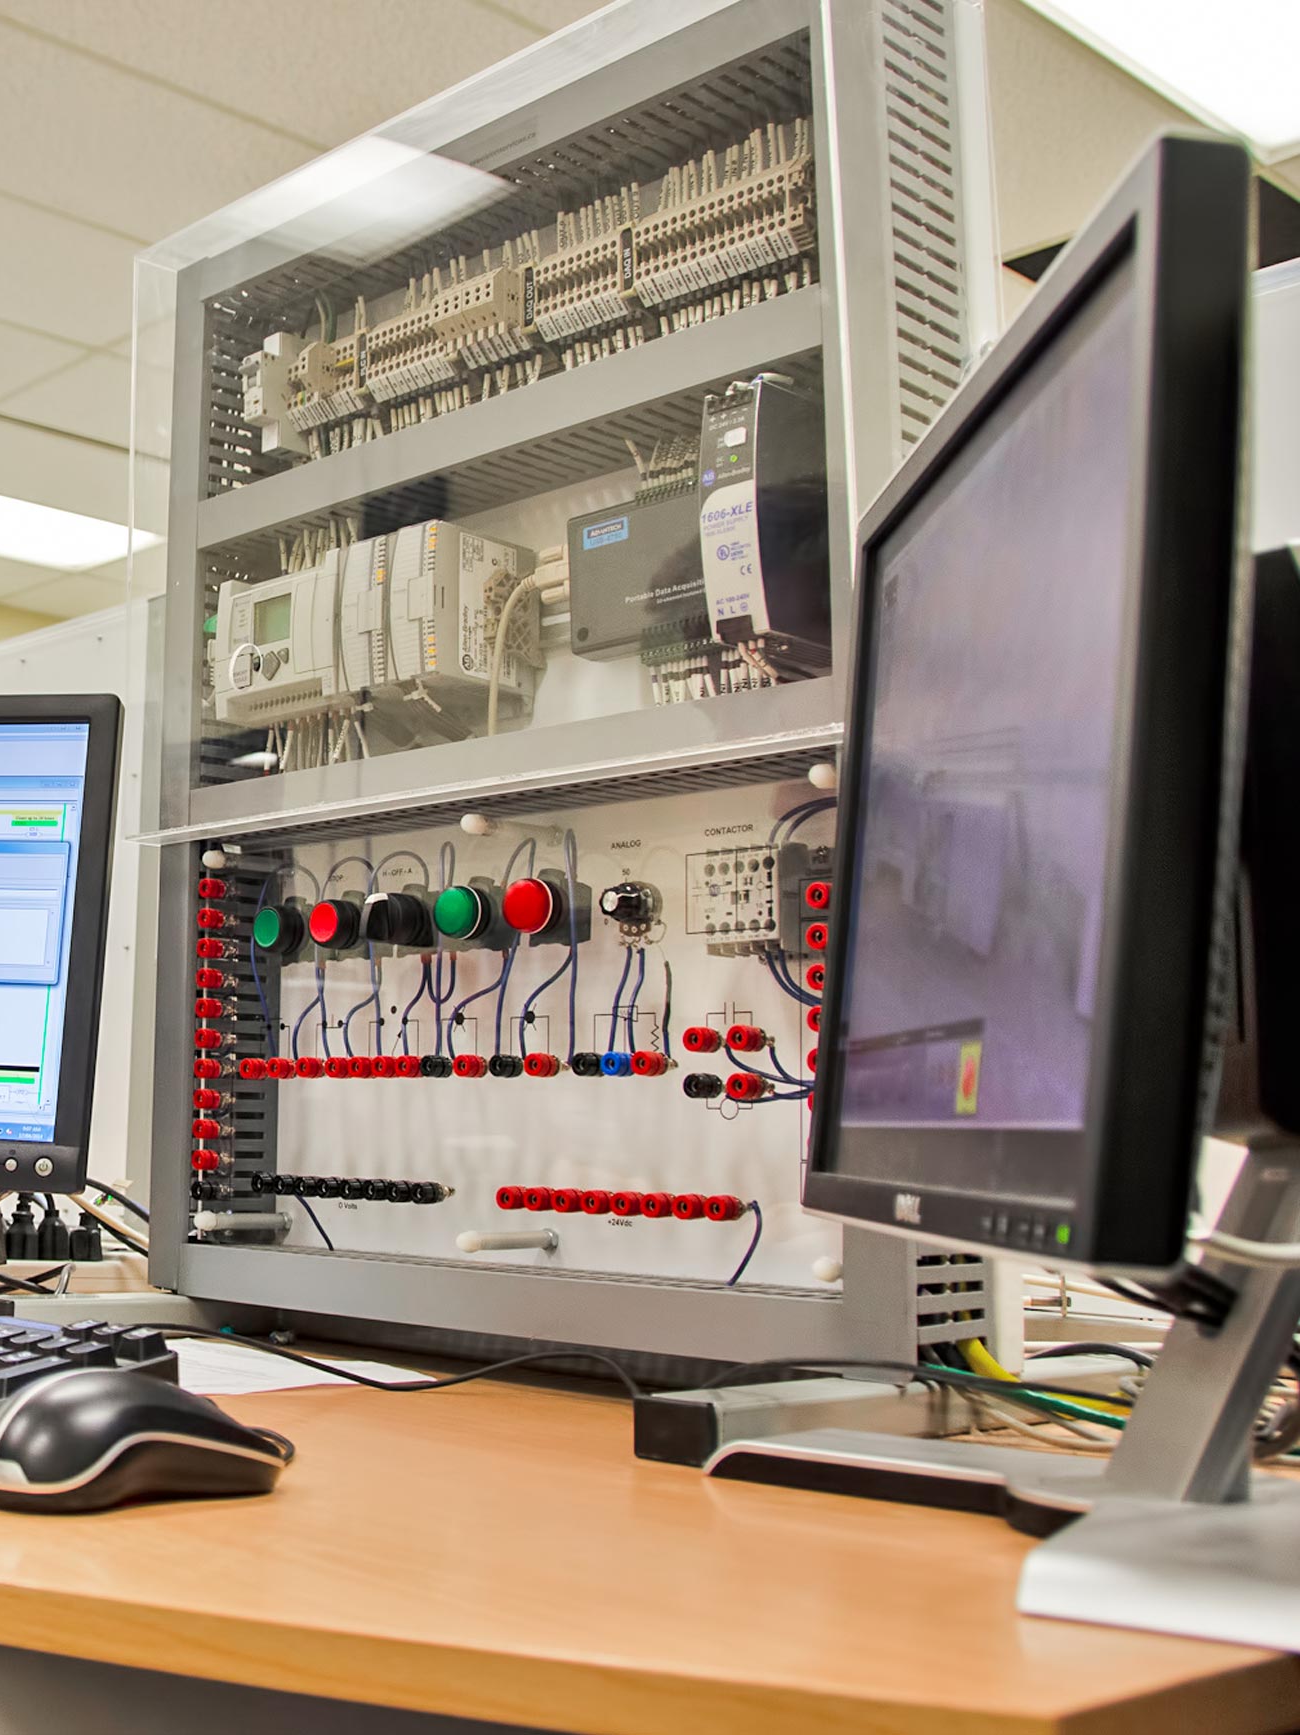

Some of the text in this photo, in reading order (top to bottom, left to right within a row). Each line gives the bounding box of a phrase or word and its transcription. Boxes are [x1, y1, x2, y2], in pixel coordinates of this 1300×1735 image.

[701, 501, 753, 523] 1606-XLE
[590, 523, 622, 537] ADVANTECH
[625, 591, 654, 604] Portable
[655, 586, 671, 597] Data
[717, 606, 736, 616] N L
[704, 824, 754, 837] CONTACTOR
[610, 839, 642, 850] ANALOG
[622, 868, 631, 876] 50
[344, 1202, 358, 1210] Volts
[607, 1218, 633, 1228] +24Vdc
